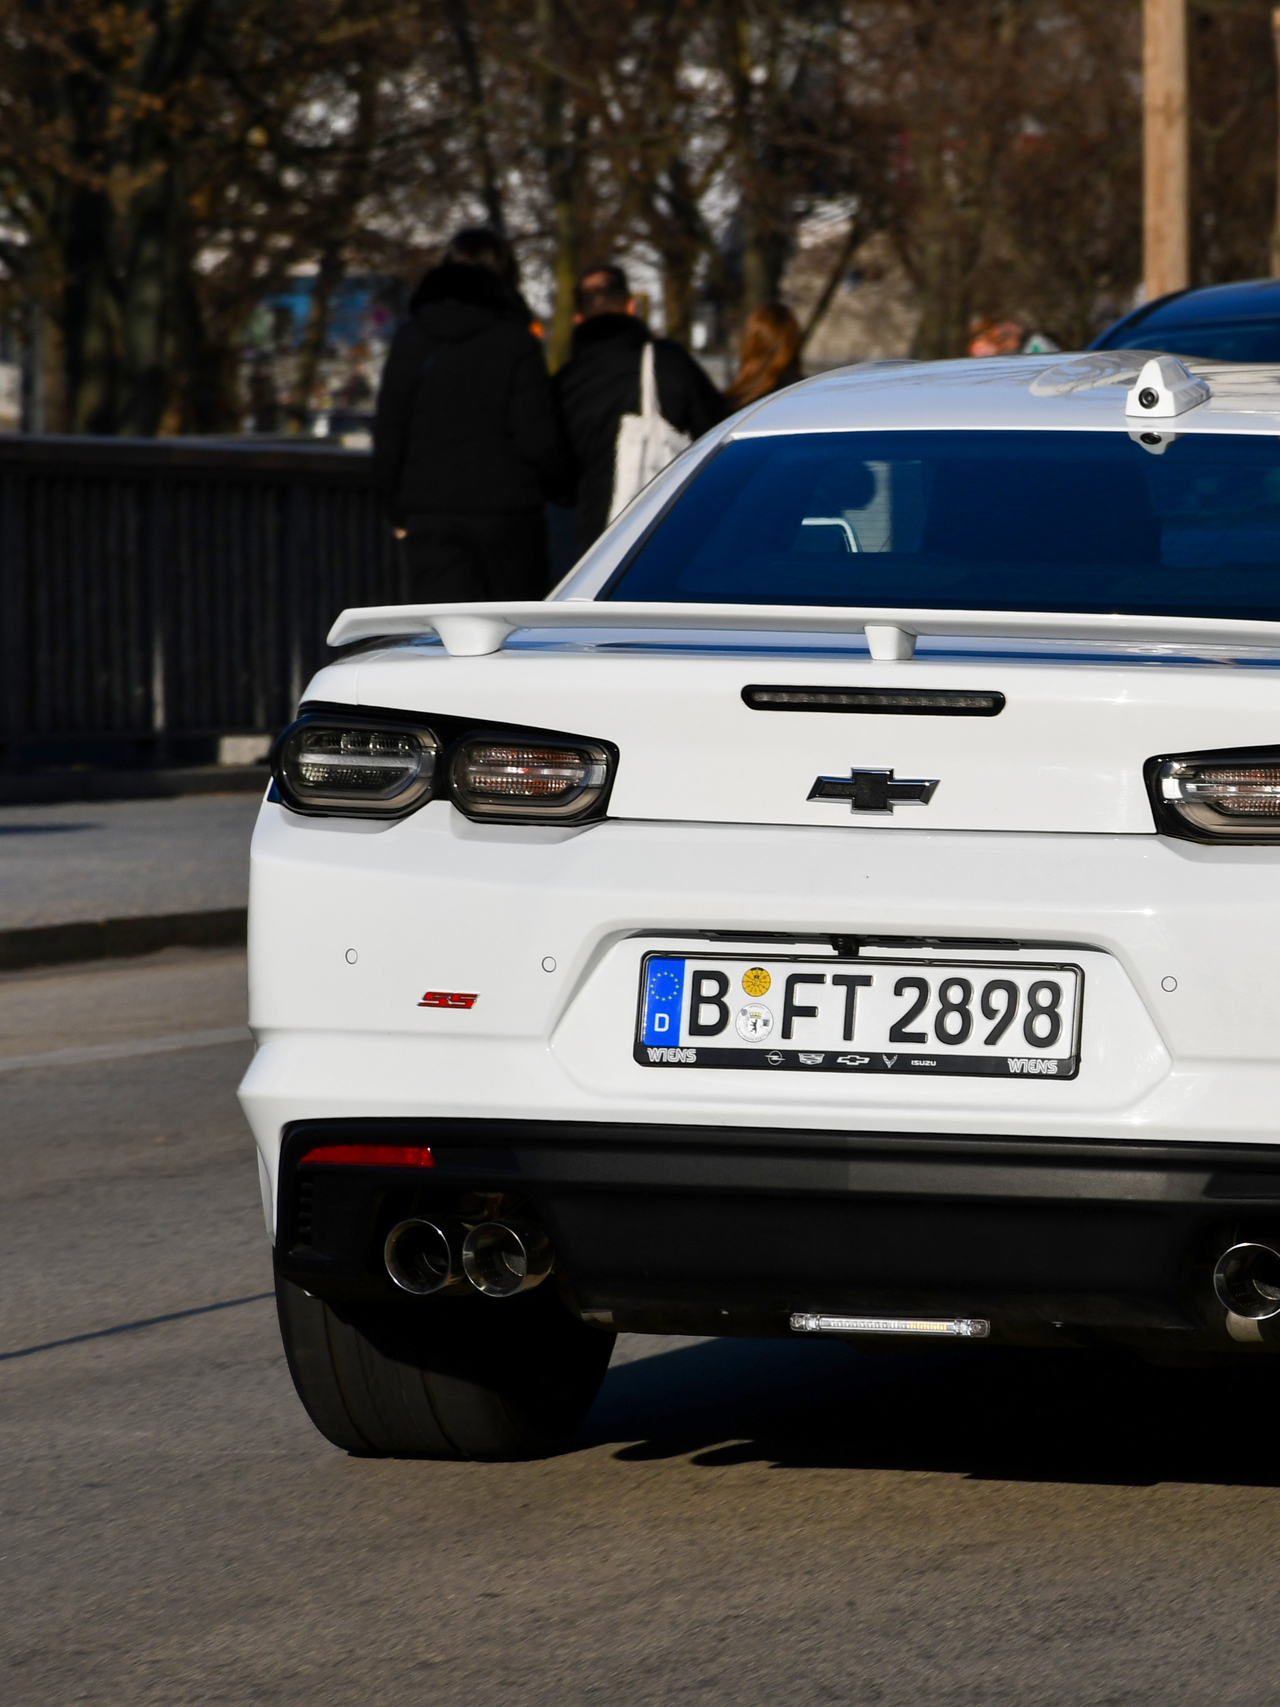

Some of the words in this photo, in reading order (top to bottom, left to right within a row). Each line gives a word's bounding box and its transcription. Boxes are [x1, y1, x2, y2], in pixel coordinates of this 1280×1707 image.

[417, 991, 480, 1009] SS
[688, 969, 731, 1037] B
[781, 973, 874, 1042] FT
[889, 976, 1064, 1049] 2898
[654, 1013, 670, 1032] D
[646, 1047, 697, 1063] WIENS
[911, 1059, 937, 1067] ISUZU
[1007, 1057, 1058, 1075] WIENS
